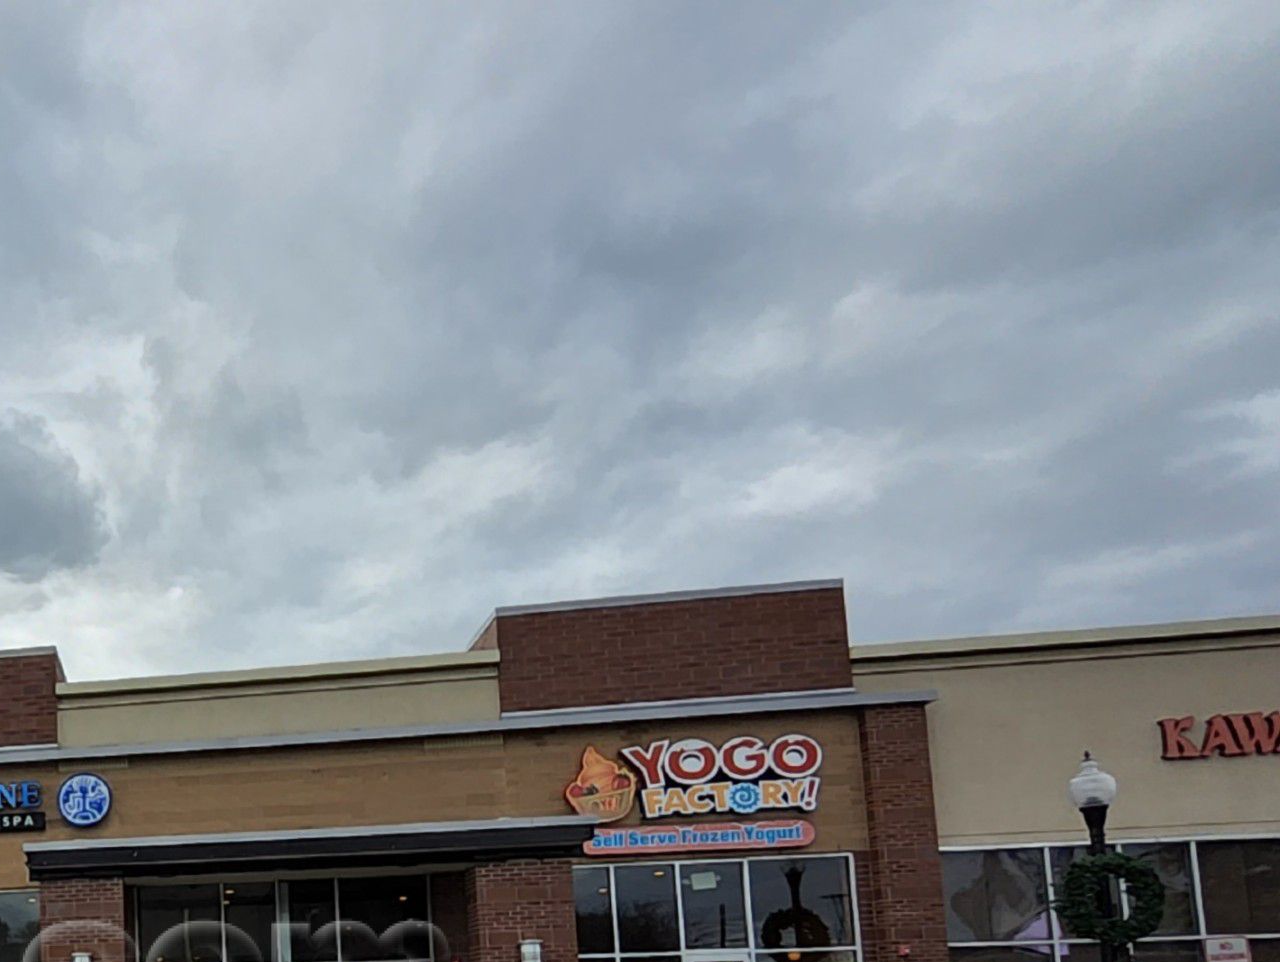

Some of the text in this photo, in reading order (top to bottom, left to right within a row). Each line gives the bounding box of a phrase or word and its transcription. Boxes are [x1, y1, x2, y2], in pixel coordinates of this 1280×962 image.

[1157, 711, 1280, 760] KAW
[621, 734, 822, 788] YOGO
[641, 777, 819, 818] FACTORY!
[2, 815, 35, 828] SPA
[629, 831, 677, 846] Serve
[682, 828, 741, 844] Frozen
[744, 825, 801, 843] Yogurt
